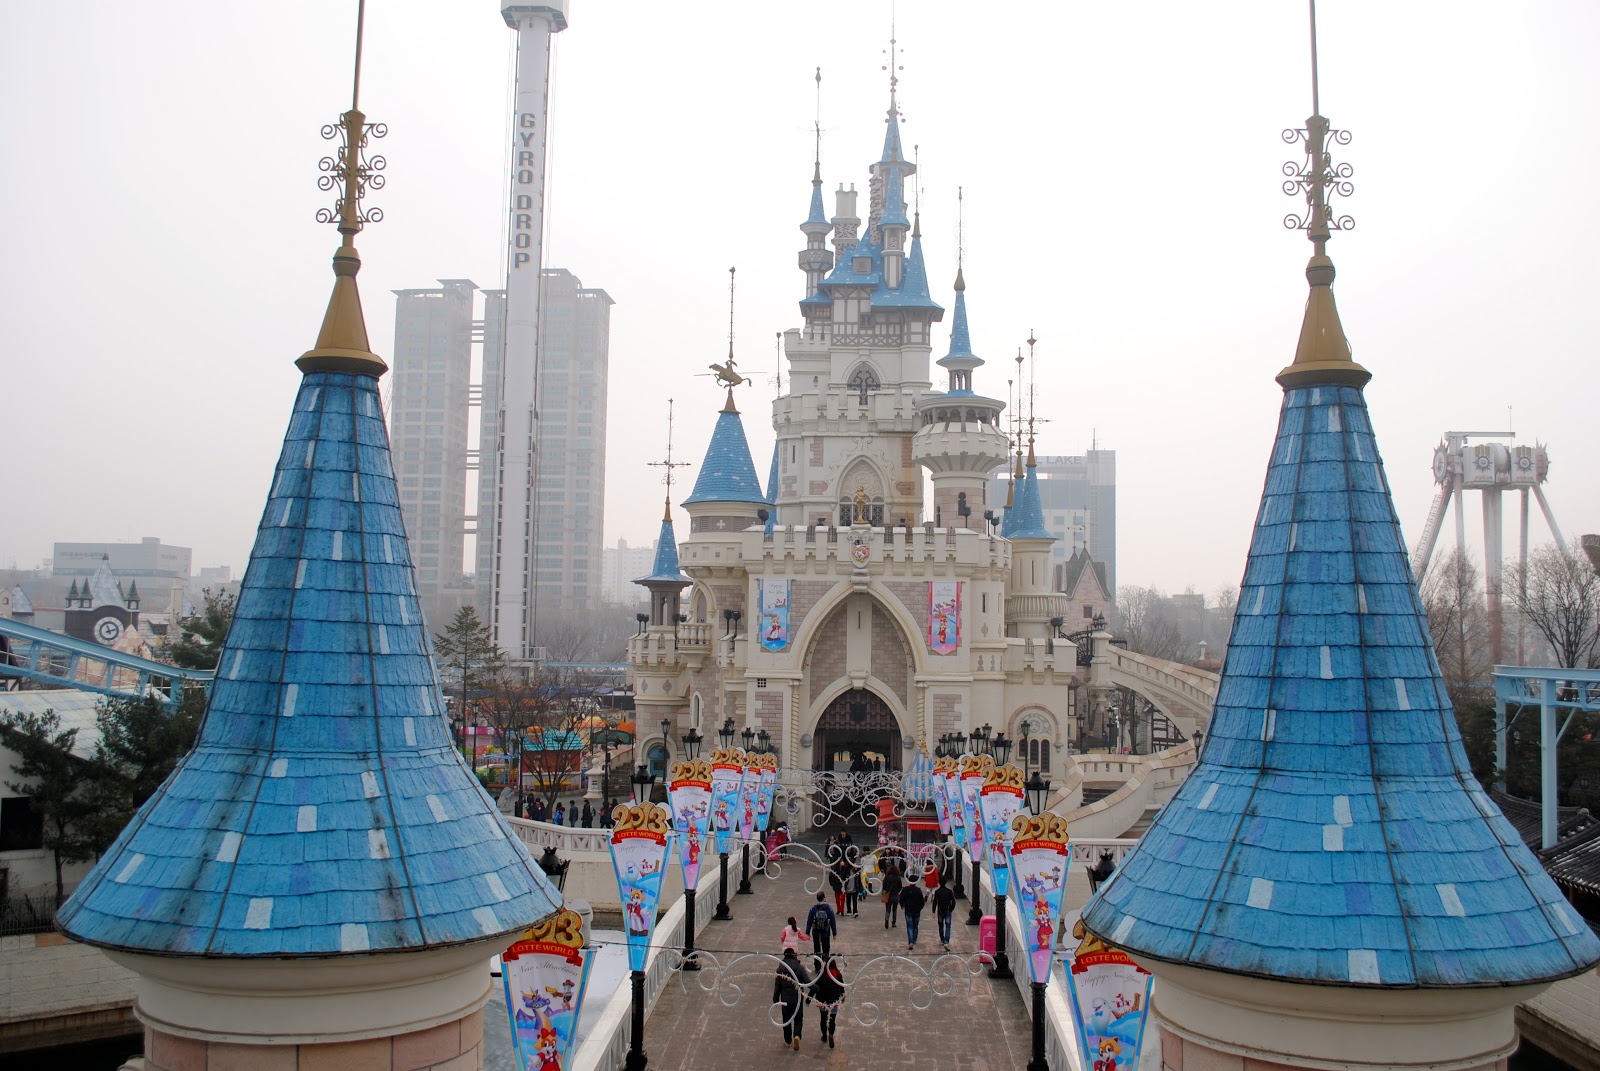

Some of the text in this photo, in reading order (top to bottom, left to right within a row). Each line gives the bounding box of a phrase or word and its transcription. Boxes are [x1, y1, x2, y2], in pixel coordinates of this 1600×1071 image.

[514, 113, 536, 269] GYRO DROP
[1047, 456, 1082, 465] LAKE
[709, 746, 745, 767] 2013
[670, 757, 713, 783] 2013
[981, 763, 1025, 789] 2013
[612, 801, 667, 834] 2013
[1012, 811, 1069, 844] 2013
[617, 831, 661, 840] LOTTE WORLD
[1017, 841, 1063, 850] LOTTE WORLD
[512, 944, 574, 956] LOTTE WORLD
[1081, 954, 1110, 965] LOTTE
